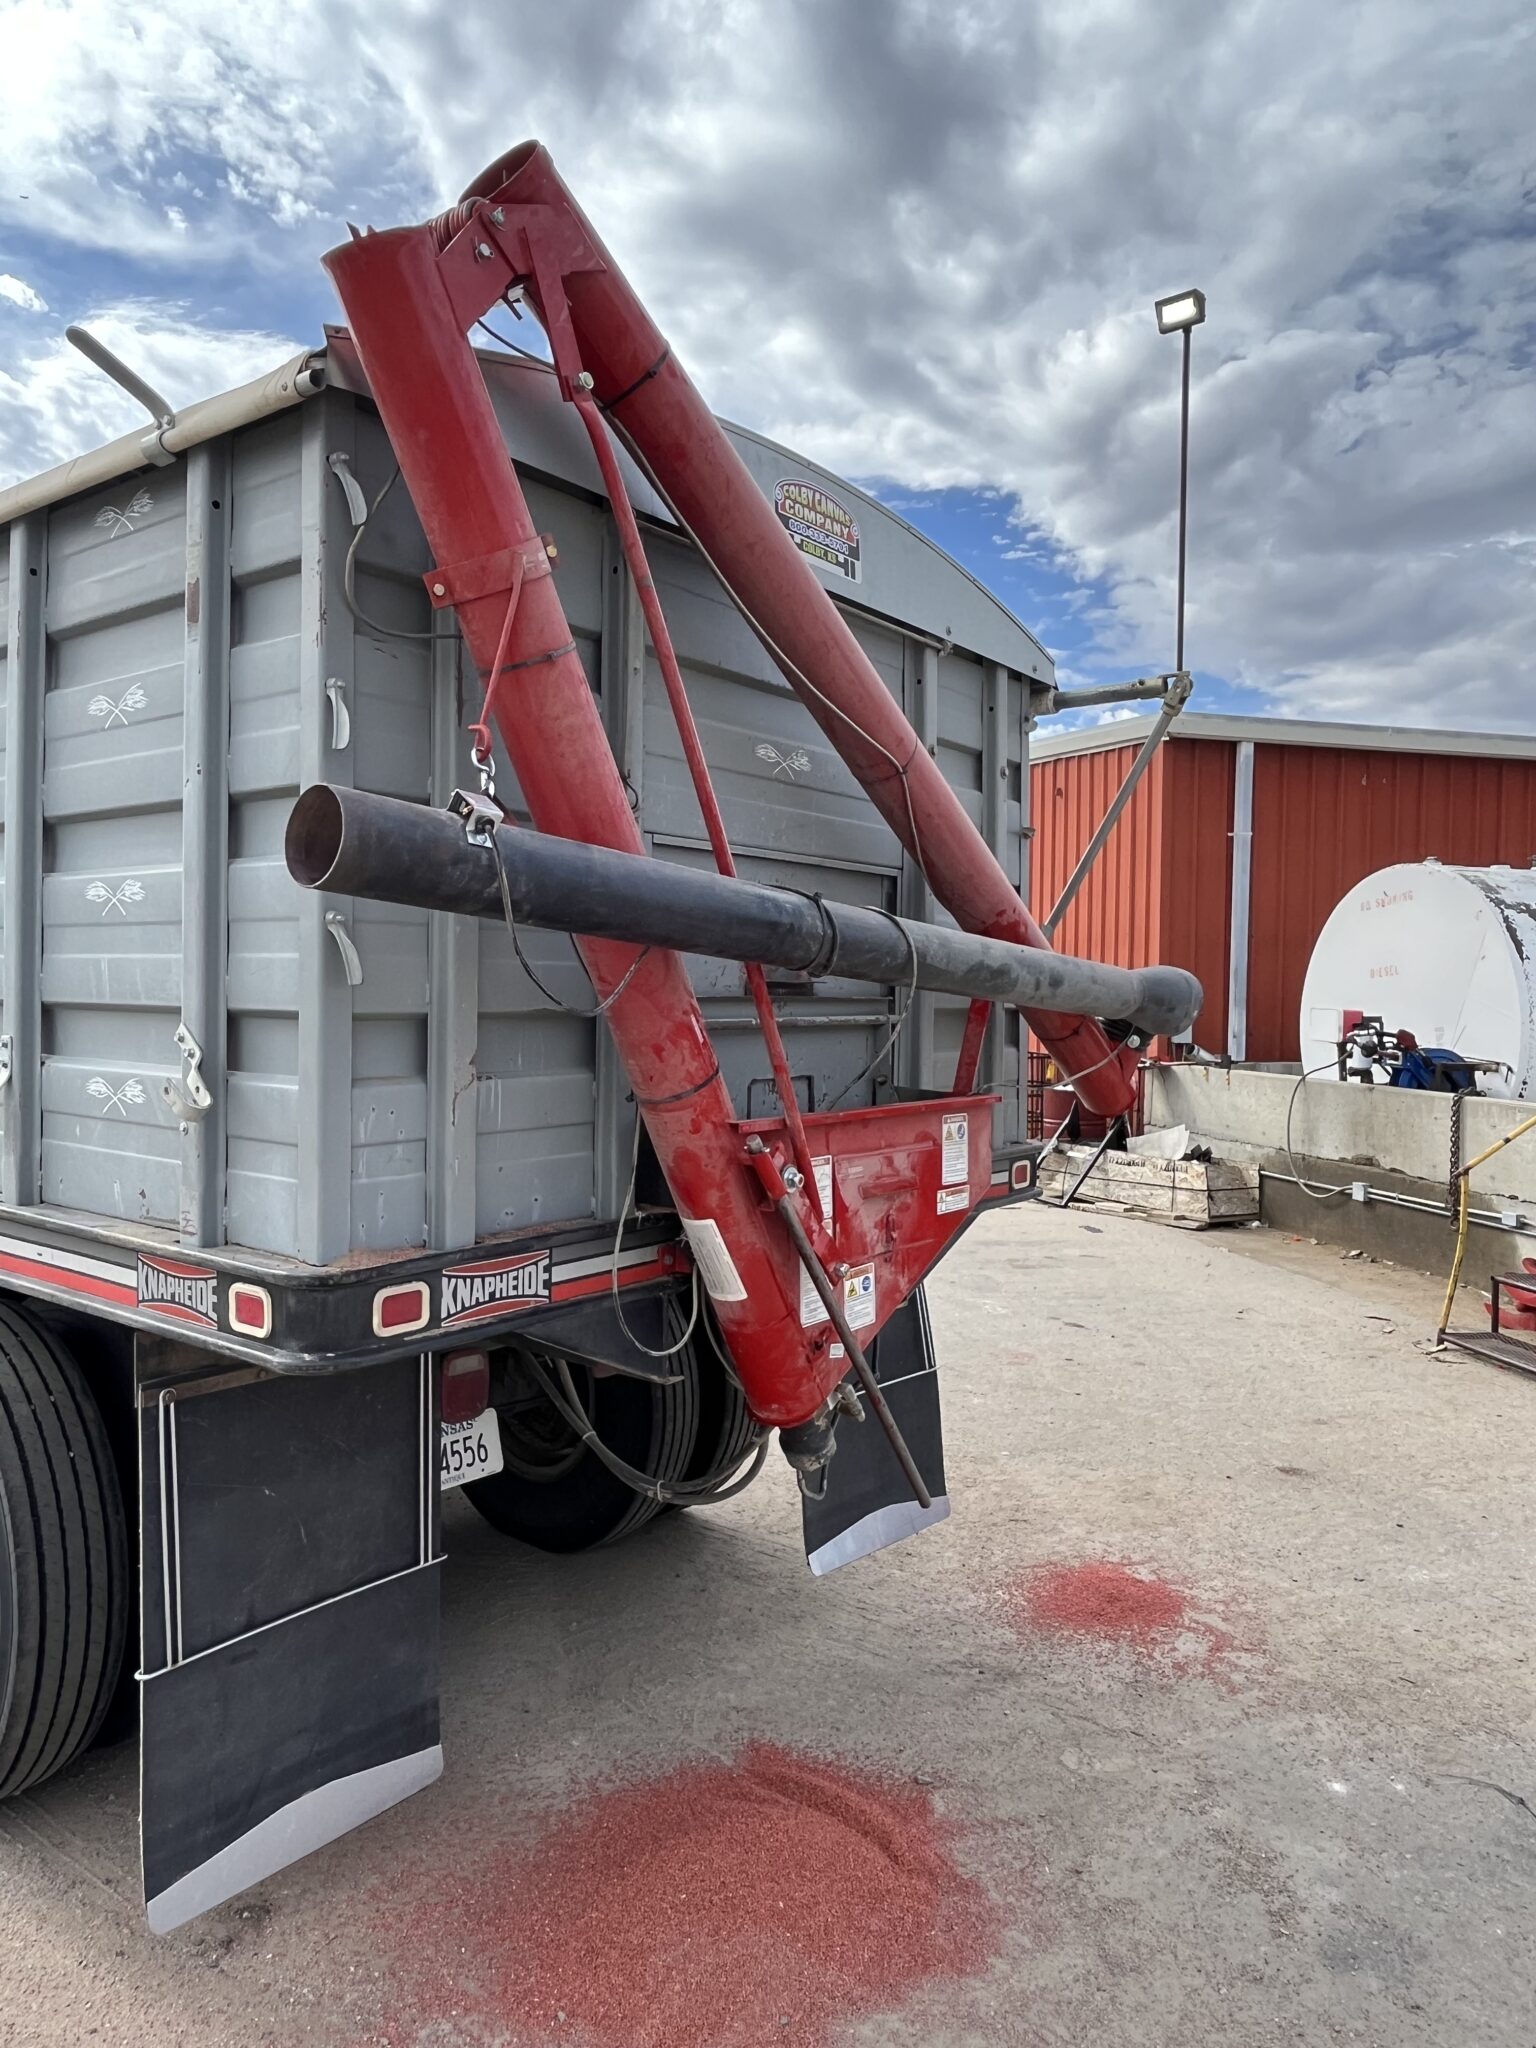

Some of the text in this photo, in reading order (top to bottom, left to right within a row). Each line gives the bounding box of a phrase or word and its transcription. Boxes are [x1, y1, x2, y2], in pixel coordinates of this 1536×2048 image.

[783, 485, 852, 526] COLBY CANVAS
[785, 499, 849, 540] COMPANY
[137, 1259, 218, 1322] KNAPHEIDE
[441, 1257, 550, 1319] KNAPHEIDE
[440, 1420, 474, 1437] NSAS
